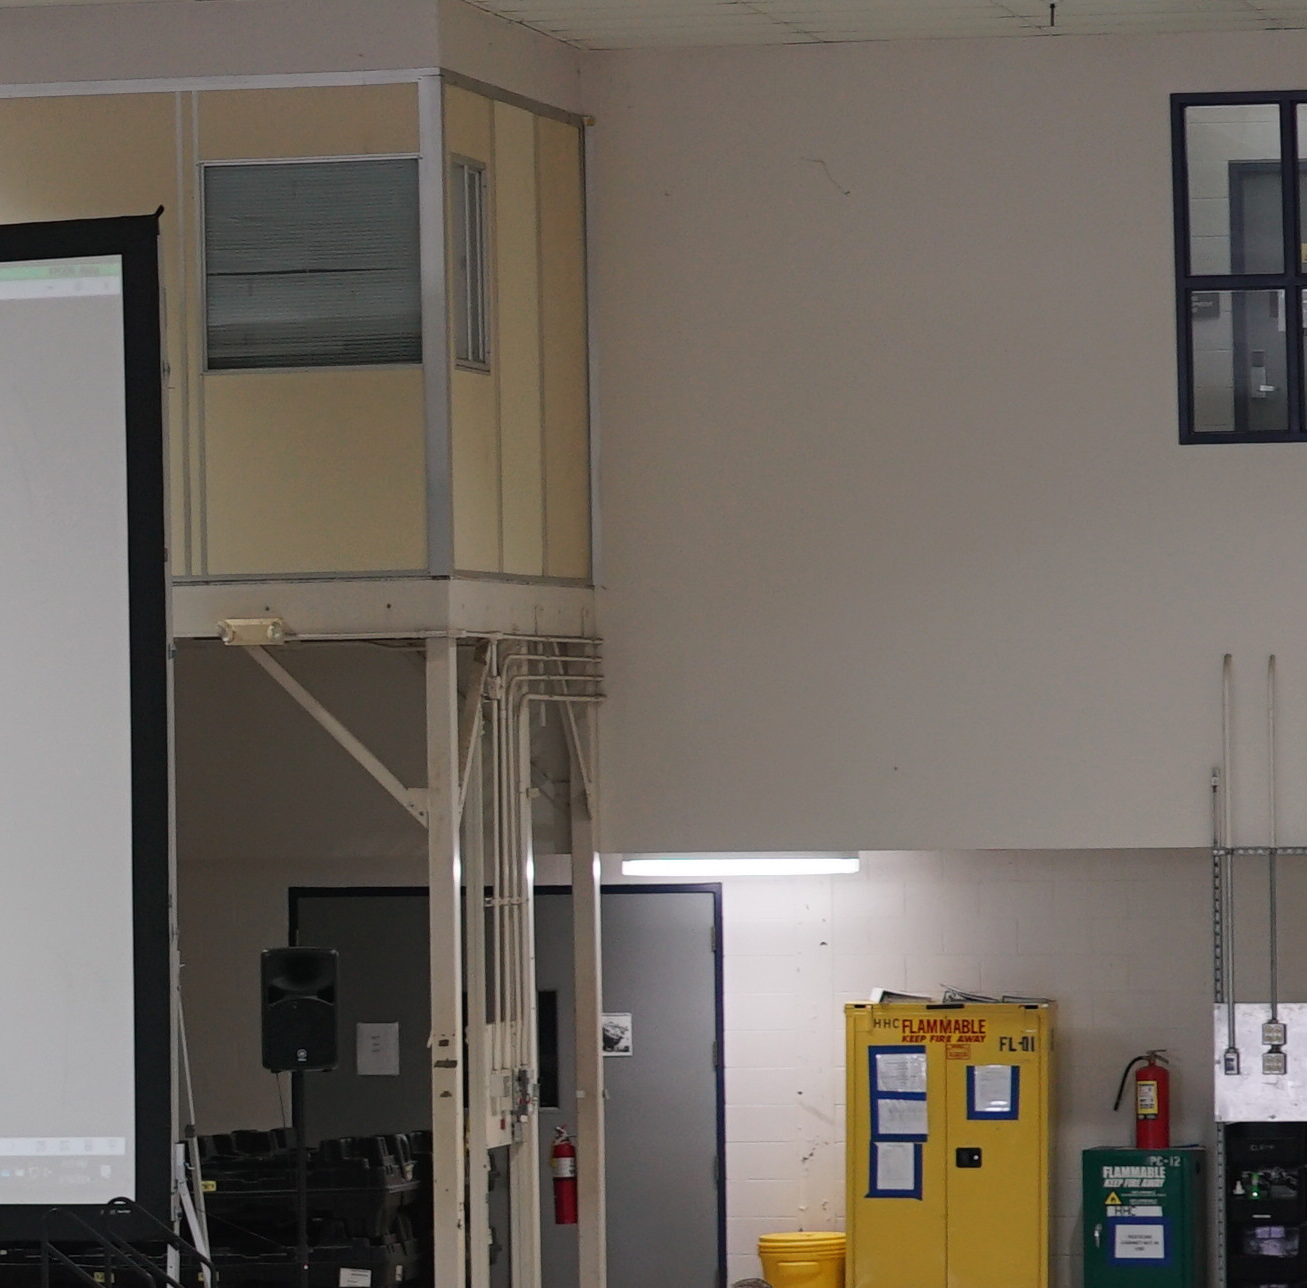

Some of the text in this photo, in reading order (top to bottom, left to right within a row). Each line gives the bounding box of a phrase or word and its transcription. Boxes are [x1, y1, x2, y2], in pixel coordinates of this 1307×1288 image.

[873, 1018, 900, 1029] HHC
[902, 1019, 987, 1034] FLAMMABLE
[902, 1035, 987, 1043] KEEP FIRE AWAY
[1149, 1156, 1181, 1167] PC-12
[1102, 1166, 1166, 1178] FLAMMABLE
[1103, 1179, 1166, 1188] KEEP FIRE AWAY
